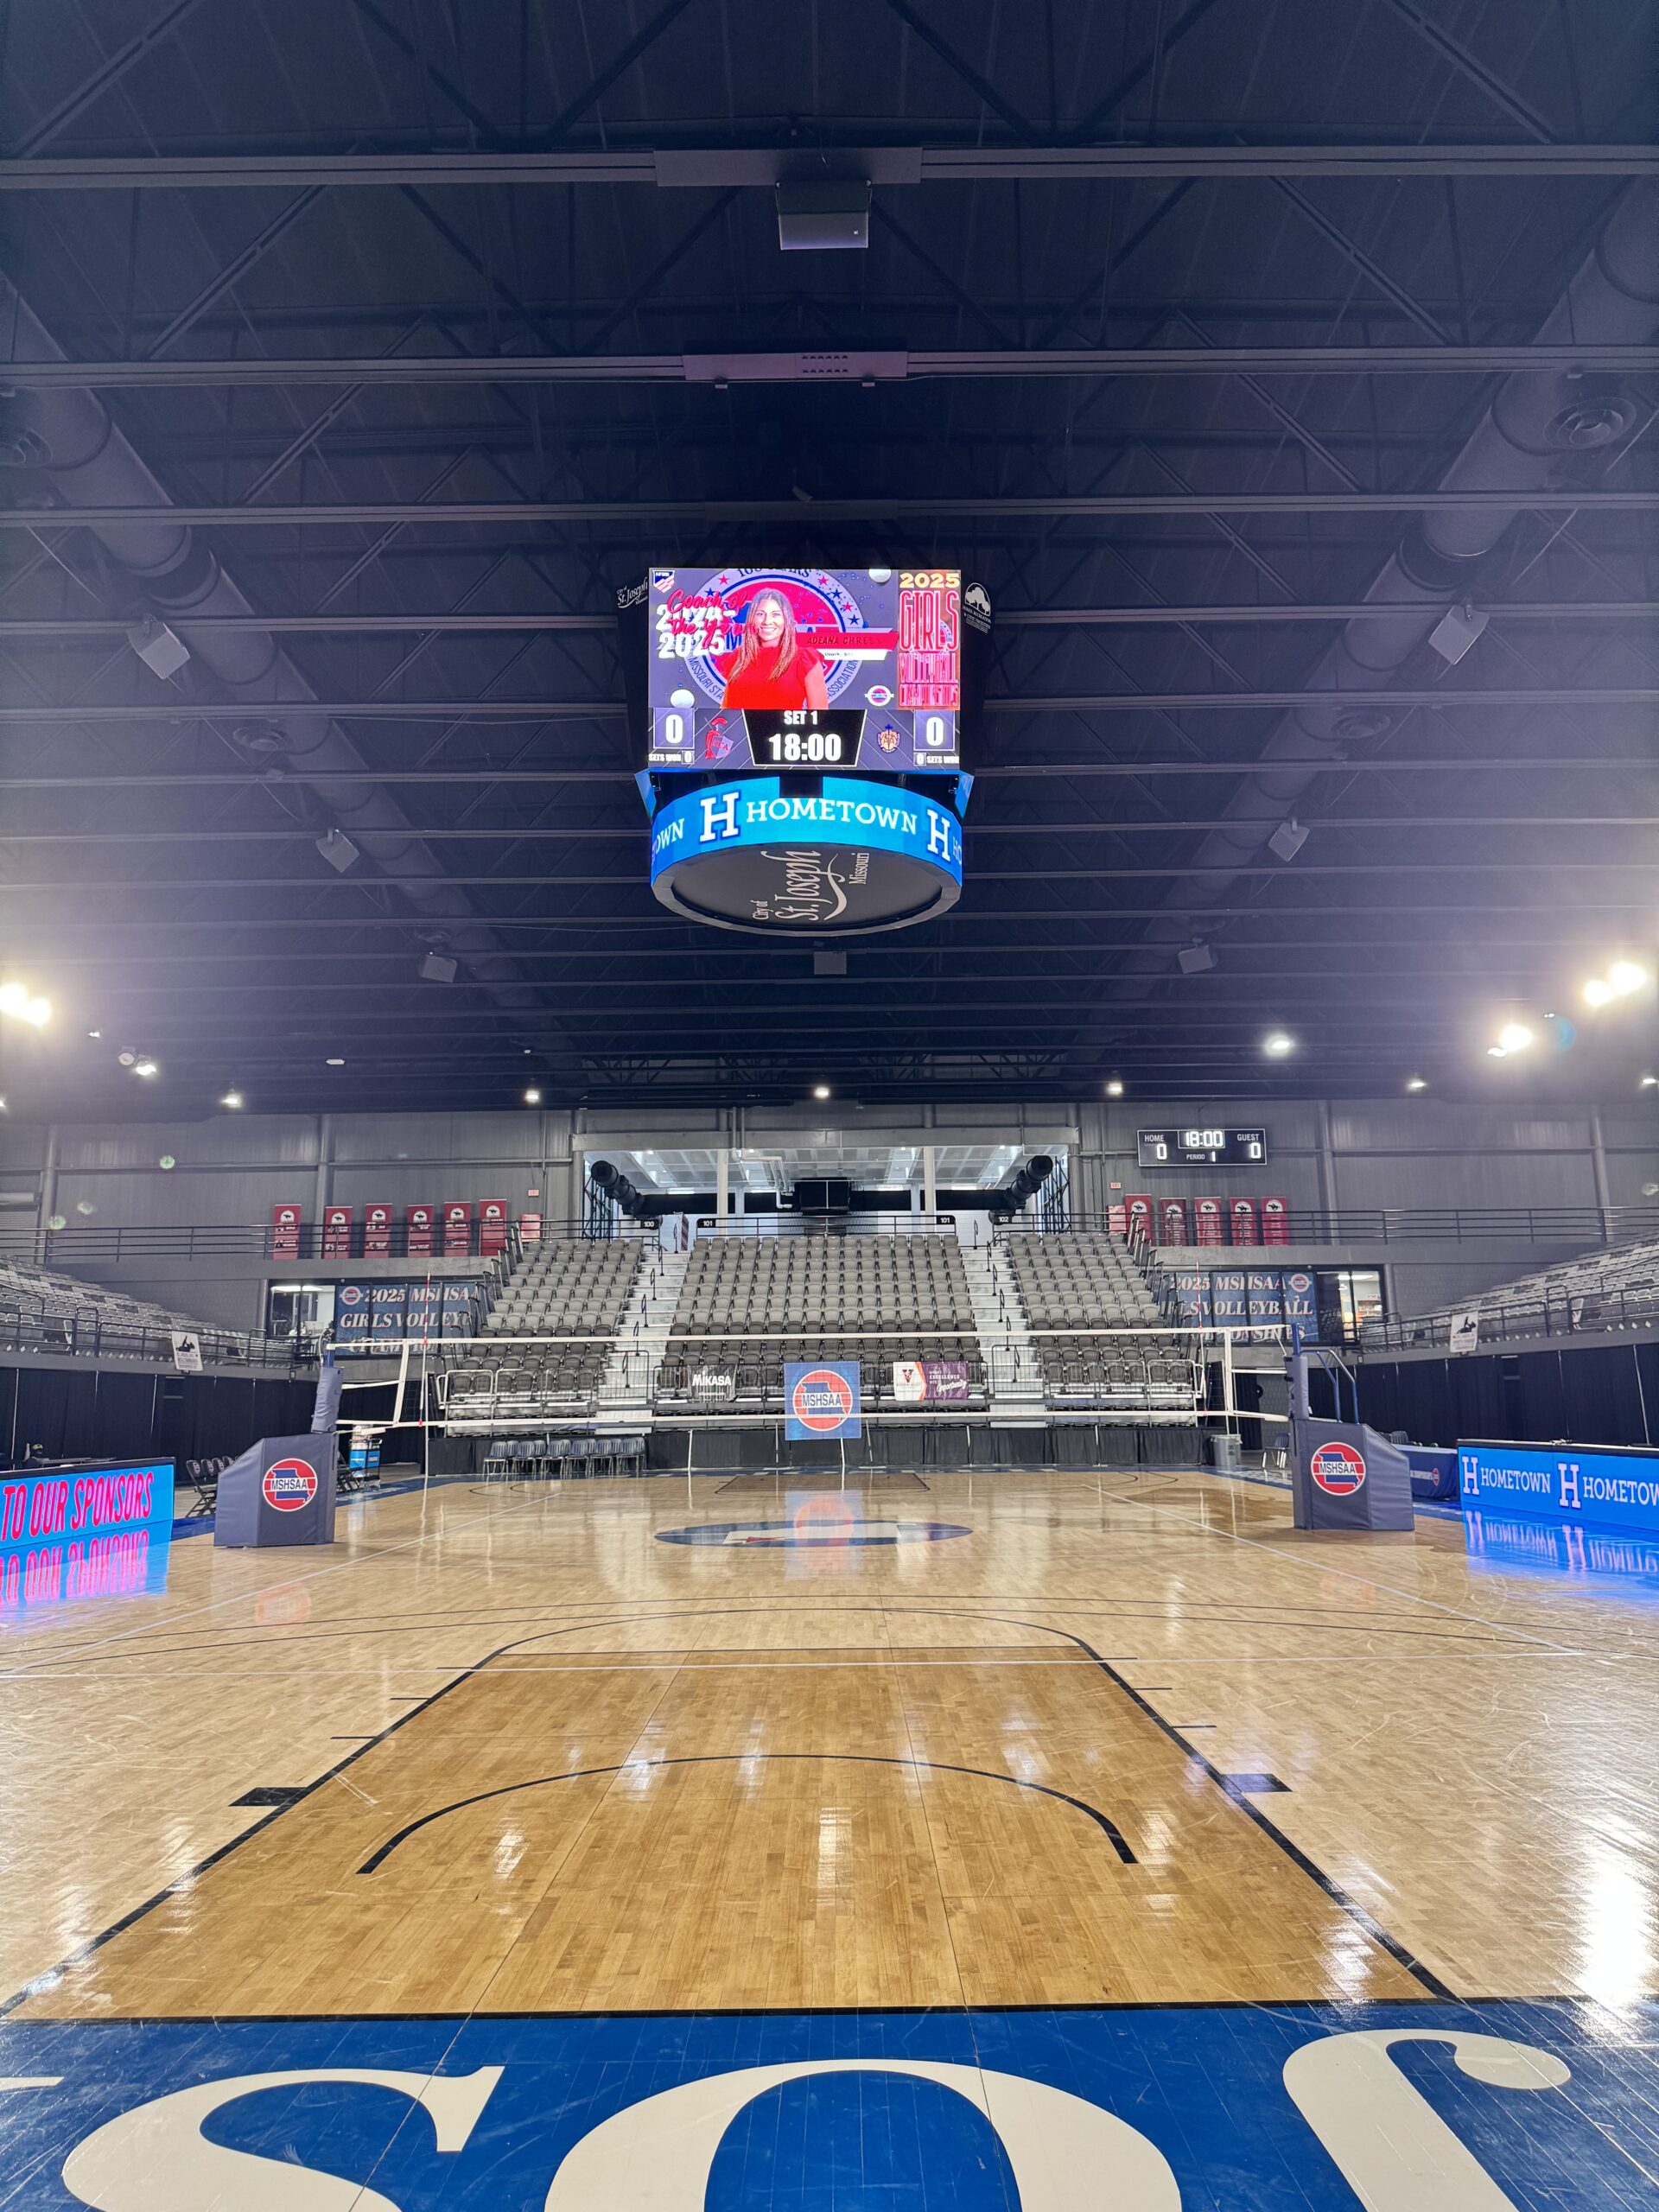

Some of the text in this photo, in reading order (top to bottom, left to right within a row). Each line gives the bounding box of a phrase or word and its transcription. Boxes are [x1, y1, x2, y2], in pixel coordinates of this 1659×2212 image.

[899, 573, 960, 588] 2025
[667, 589, 723, 614] Coach
[899, 590, 960, 651] GIRLS
[688, 657, 714, 689] MISSOURI
[783, 710, 818, 725] SET 1
[665, 715, 683, 744] 0
[925, 716, 944, 747] 0
[768, 733, 842, 761] 18:00
[700, 791, 740, 842] H
[747, 798, 918, 836] HOMETOWN
[926, 808, 951, 862] H
[848, 852, 870, 885] Missouri
[760, 850, 846, 921] St. Joseph
[753, 909, 774, 921] City
[1185, 1130, 1224, 1147] 18:00
[1236, 1133, 1260, 1141] GUEST
[1156, 1143, 1167, 1160] 0
[1211, 1151, 1217, 1163] 1
[1250, 1142, 1262, 1159] 0
[365, 1287, 407, 1303] 2025
[1202, 1300, 1313, 1316] VOLLEYBALL
[340, 1313, 393, 1328] GIRLS
[802, 1393, 842, 1407] MSHSAA
[1319, 1462, 1356, 1474] MSHSAA
[271, 1478, 308, 1491] MSHSAA
[1461, 1456, 1480, 1495] H
[1480, 1467, 1551, 1493] HOMETOWN
[1558, 1463, 1581, 1509] H
[1, 1471, 154, 1541] TO OUR SPONSORS
